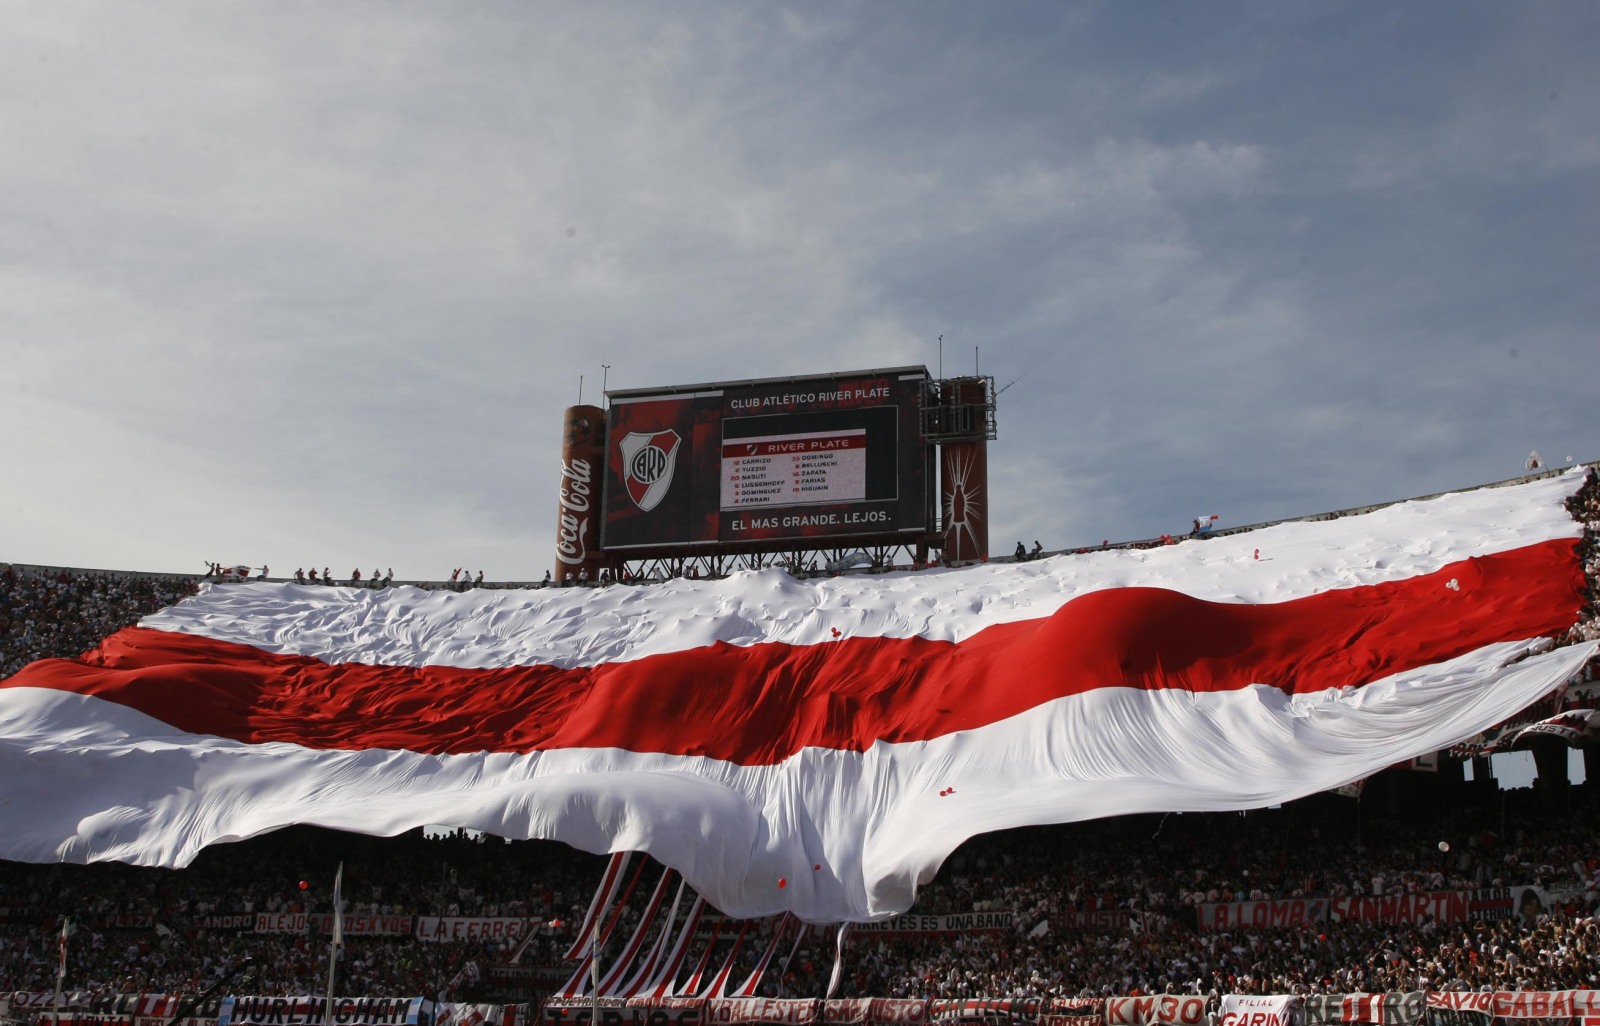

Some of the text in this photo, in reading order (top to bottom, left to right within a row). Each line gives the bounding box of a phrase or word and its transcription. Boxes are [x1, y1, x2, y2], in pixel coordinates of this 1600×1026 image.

[731, 387, 890, 410] CLUB ATLÉTICO RIVER PLATE
[768, 439, 849, 453] RIVER PLATE
[801, 453, 833, 461] DOMINGO
[801, 461, 838, 469] BELLUSCHI
[741, 480, 785, 488] LUSSENHOFF
[741, 488, 781, 496] DOMINGUEZ
[556, 458, 592, 565] Coca-Cola
[732, 511, 892, 531] EL MAS GRANDE. LEJOS.
[258, 915, 305, 930] ALEJO
[855, 915, 918, 931] IRREYES
[921, 916, 938, 930] ES
[946, 914, 974, 929] UNA
[976, 913, 1013, 928] BAND
[1237, 900, 1305, 930] LOMA
[1238, 999, 1273, 1007] FILIAL
[1426, 991, 1492, 1011] SAVIO
[231, 997, 412, 1025] HURLINGHAM
